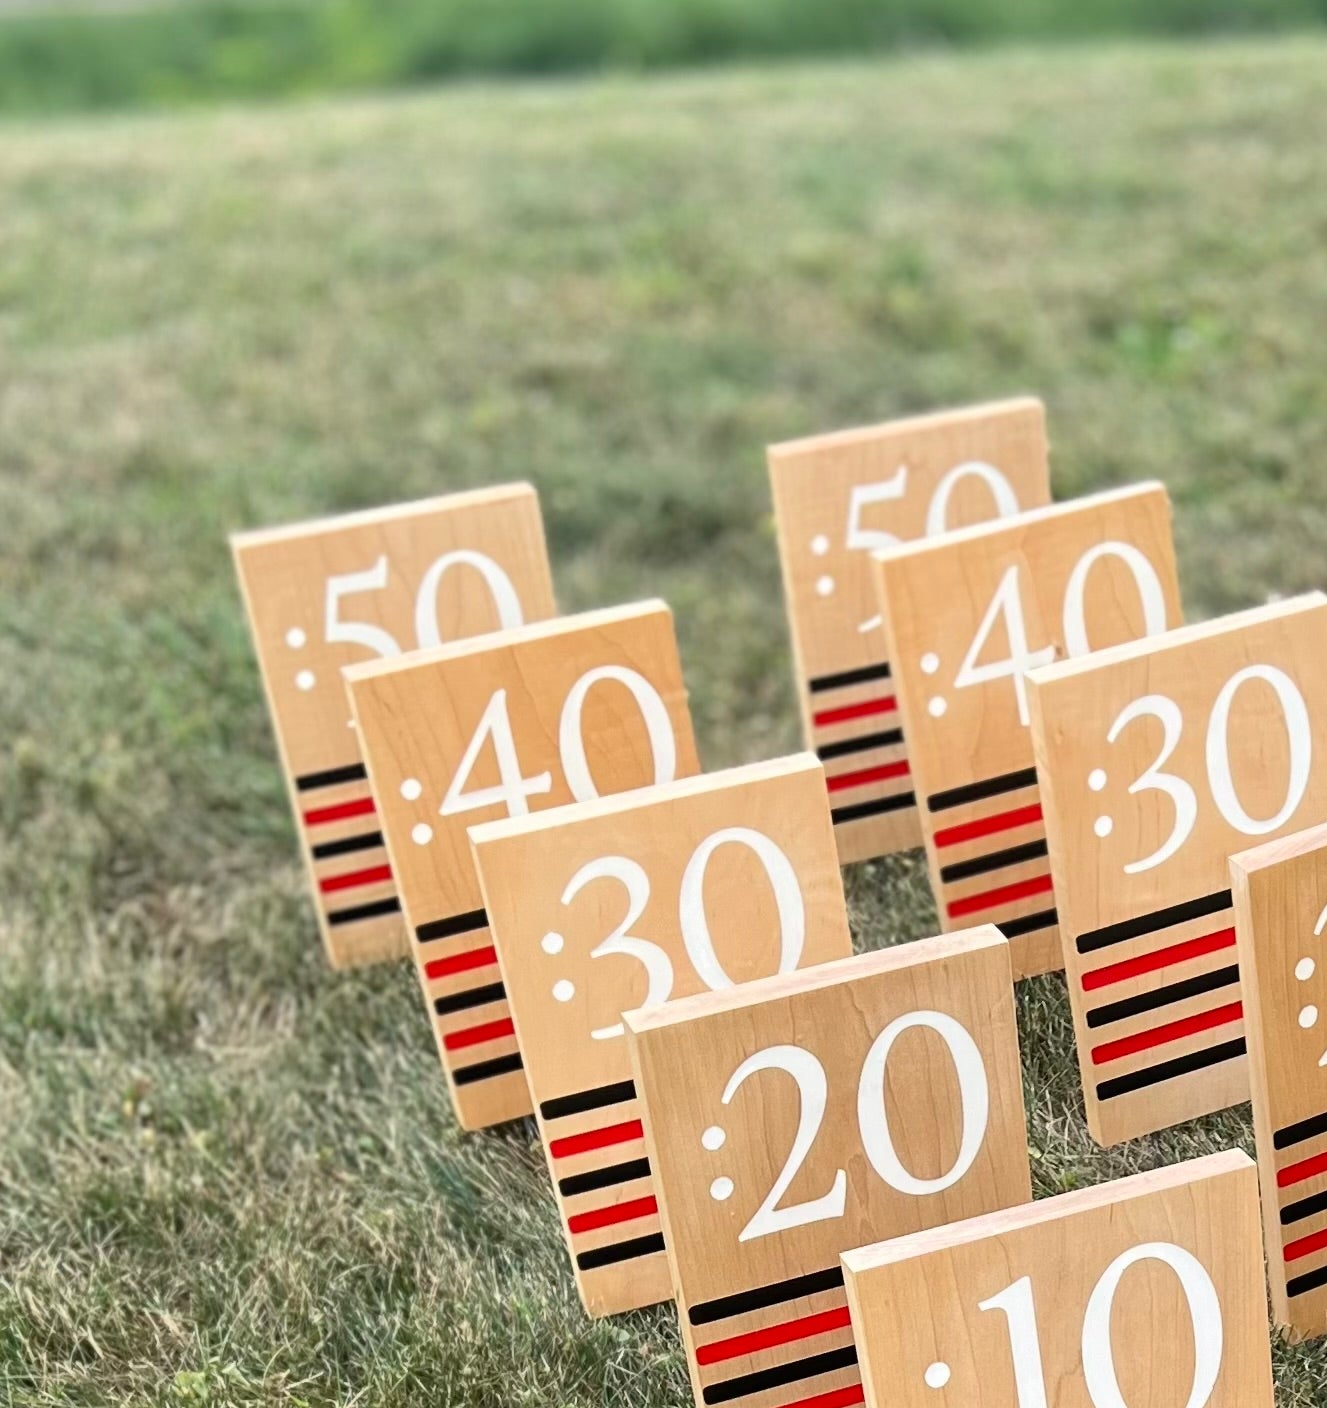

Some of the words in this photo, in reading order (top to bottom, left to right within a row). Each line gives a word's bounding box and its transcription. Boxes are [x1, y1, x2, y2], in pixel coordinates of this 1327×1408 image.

[920, 541, 1167, 727] :40
[400, 664, 677, 845] :40
[1088, 664, 1312, 874] :30
[541, 827, 805, 1040] :30
[701, 1010, 989, 1242] :20
